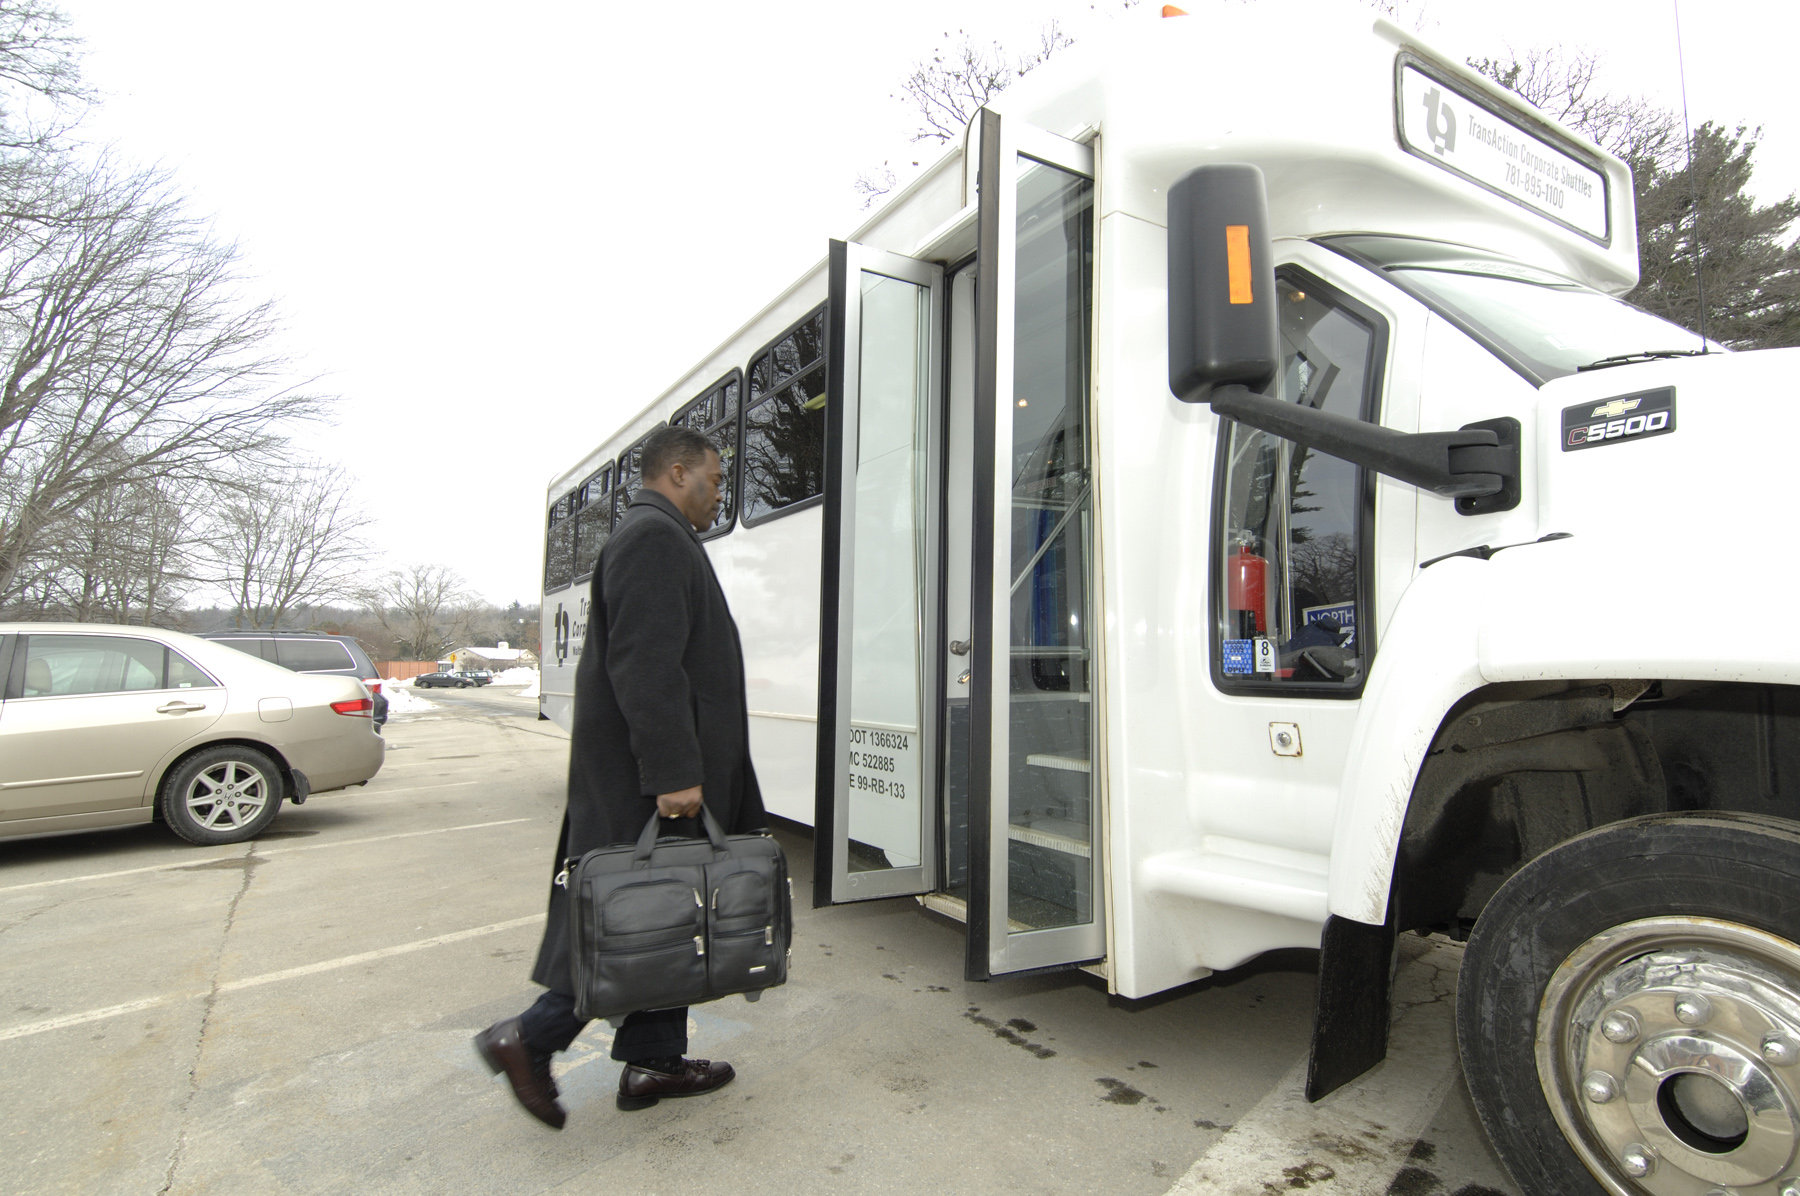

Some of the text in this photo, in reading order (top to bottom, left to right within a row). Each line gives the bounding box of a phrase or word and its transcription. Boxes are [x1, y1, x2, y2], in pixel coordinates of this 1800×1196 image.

[1468, 114, 1592, 198] TransAction Corporate Shuttles
[1505, 162, 1564, 209] 781-895-1100
[1567, 411, 1669, 446] C5500
[1261, 641, 1270, 656] 8
[869, 731, 909, 751] 1366324
[862, 753, 895, 773] 522885
[857, 775, 905, 800] 99-RB-133
